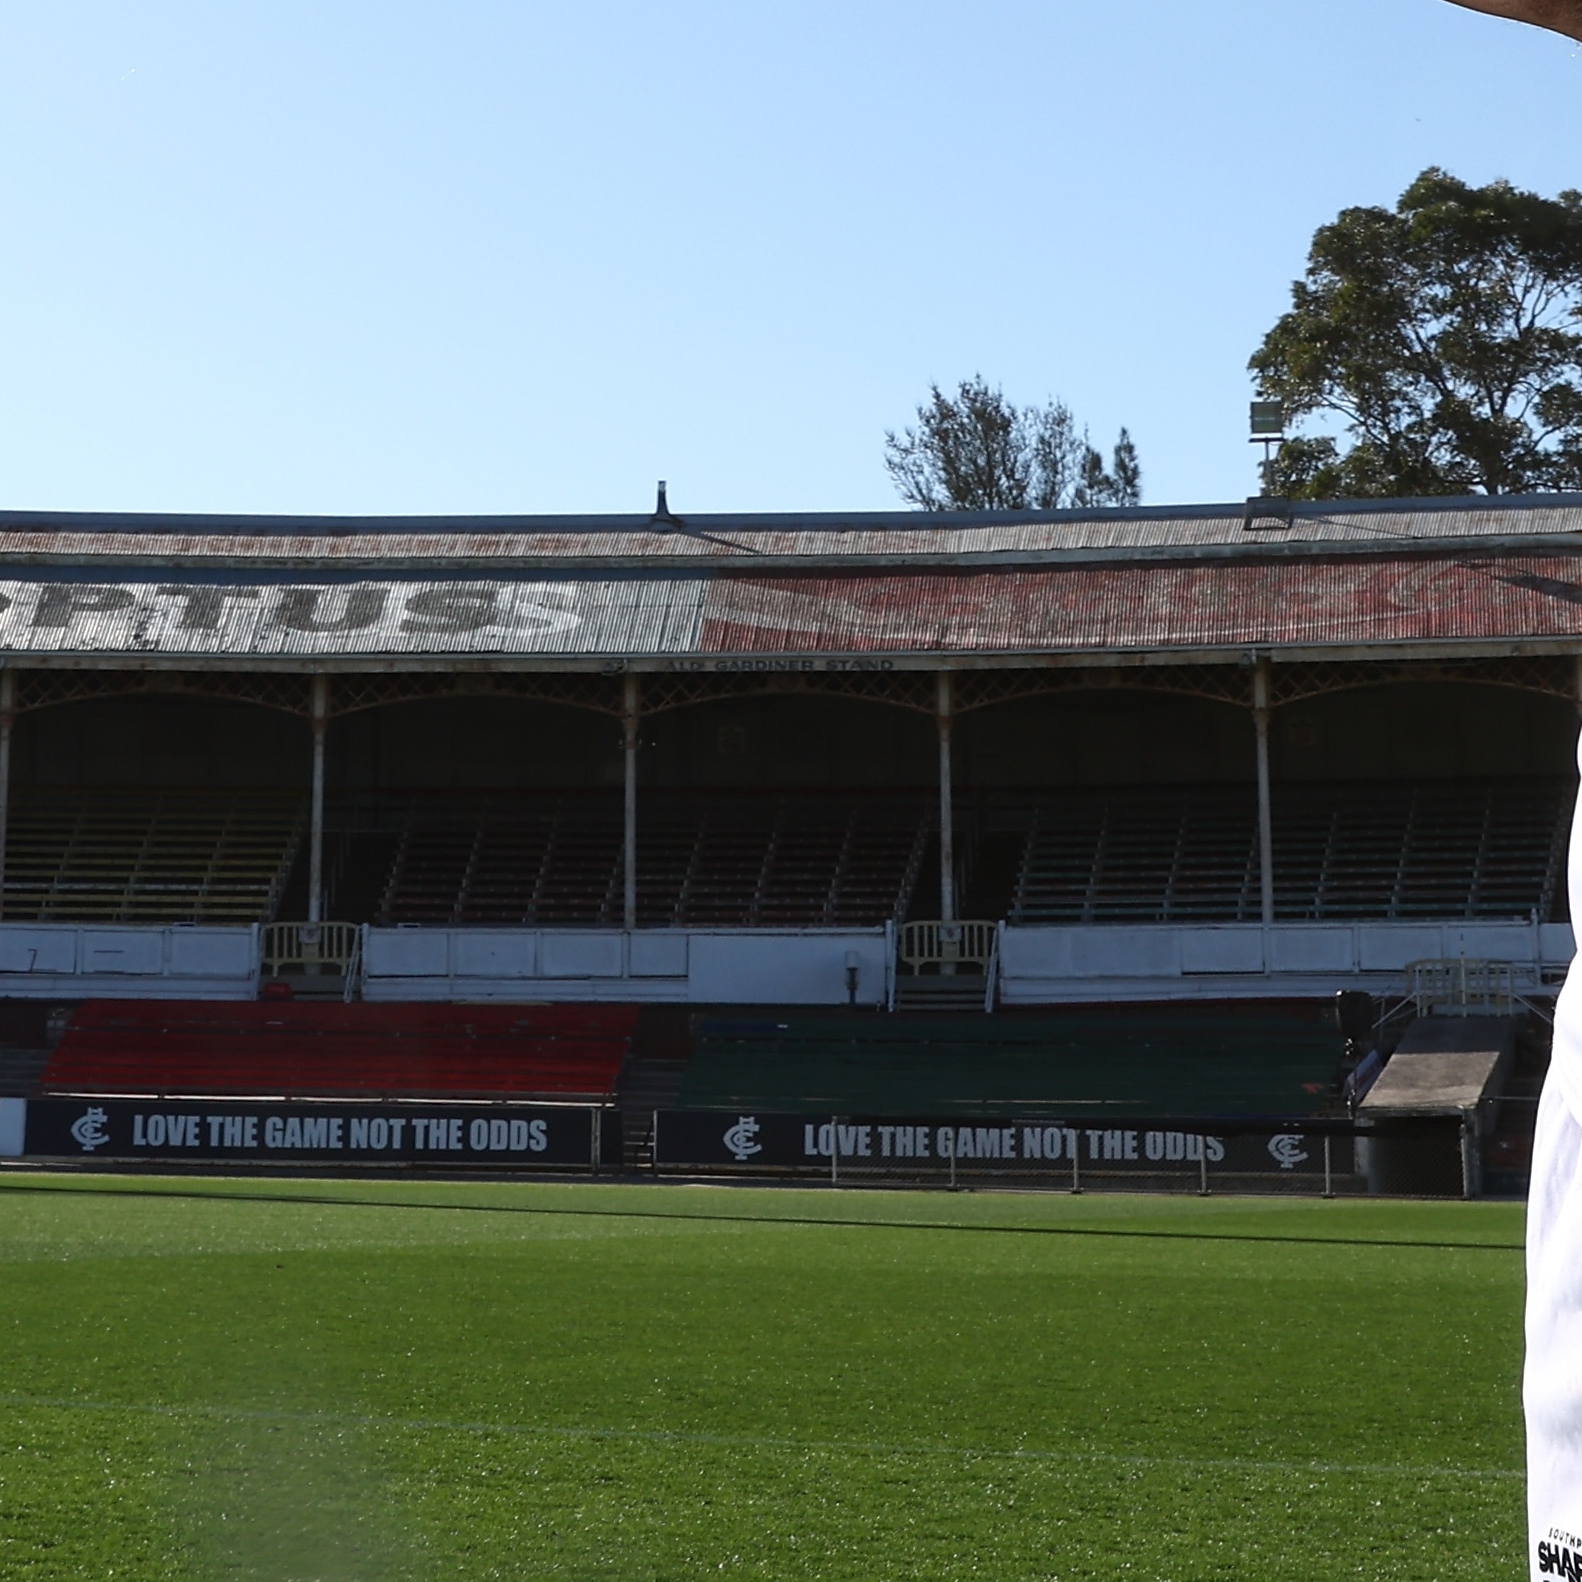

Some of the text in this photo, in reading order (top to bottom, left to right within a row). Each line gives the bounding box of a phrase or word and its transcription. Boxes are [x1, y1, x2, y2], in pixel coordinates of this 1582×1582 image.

[715, 660, 815, 671] GARDINER
[825, 660, 894, 671] STAND
[132, 1113, 548, 1152] LOVE THE GAME NOT THE ODDS
[804, 1124, 1226, 1162] LOVE THE GAME NOT THE ODDS
